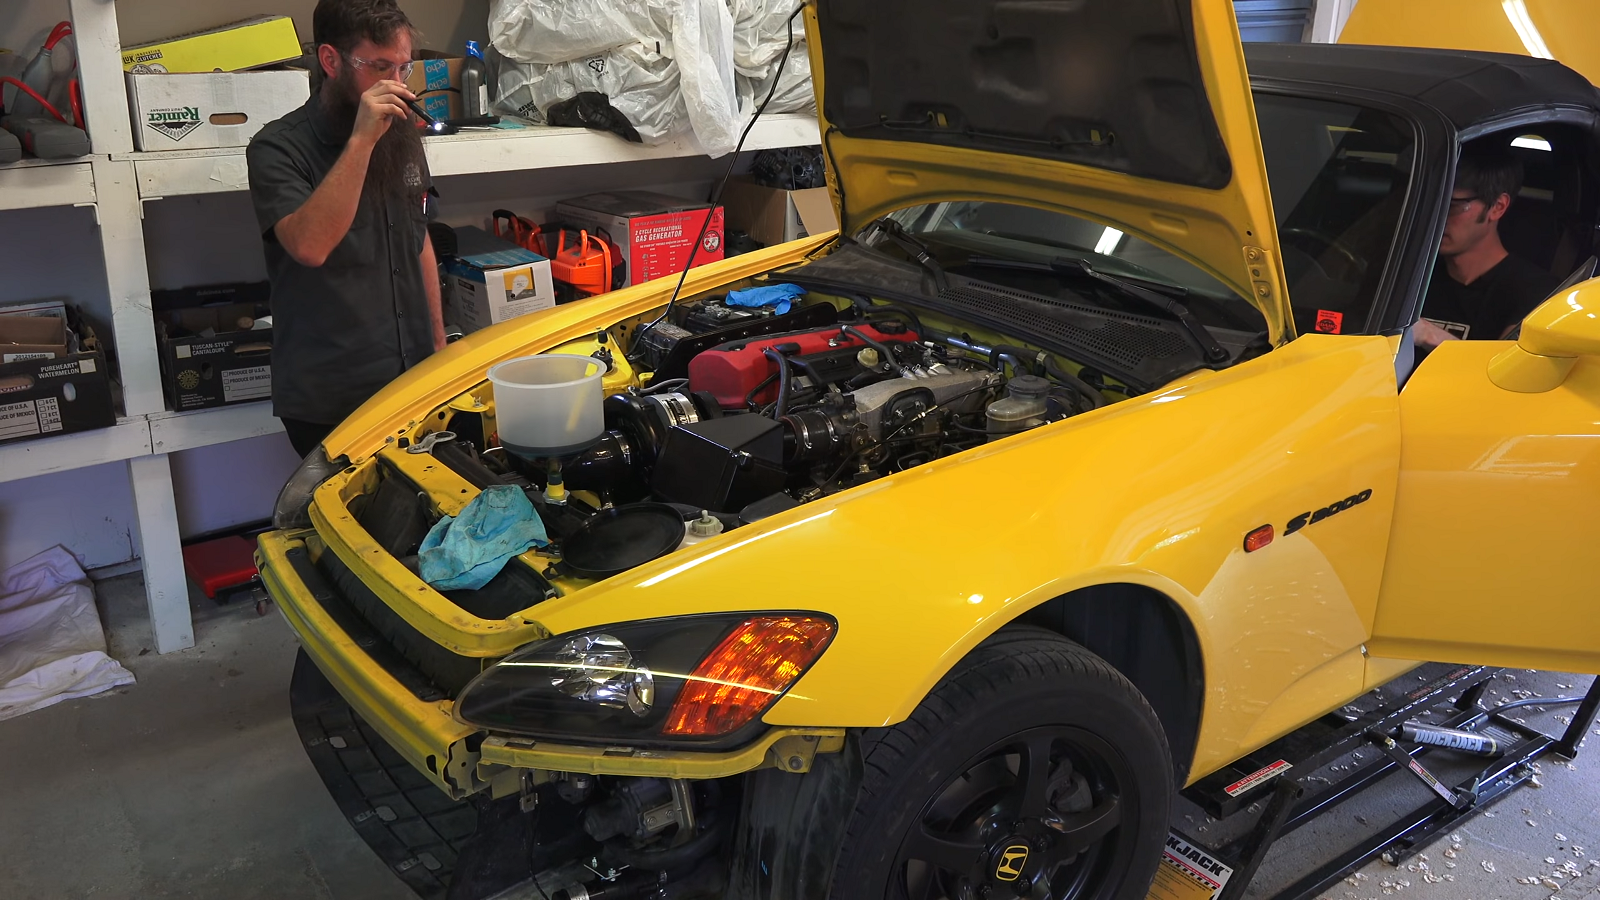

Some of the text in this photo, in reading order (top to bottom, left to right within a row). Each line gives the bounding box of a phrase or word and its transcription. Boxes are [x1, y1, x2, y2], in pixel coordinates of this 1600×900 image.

[136, 53, 163, 63] CLUTCHES
[426, 60, 446, 73] echo
[427, 78, 448, 89] echo
[426, 99, 447, 110] echo
[148, 106, 201, 122] Rainier
[653, 225, 682, 233] RECREATIONAL
[649, 230, 682, 241] GENERATOR
[192, 347, 225, 356] CANTALOUPE
[38, 368, 79, 379] WATERMELON
[16, 410, 35, 418] MEXICO
[1240, 766, 1270, 786] ATTENTION
